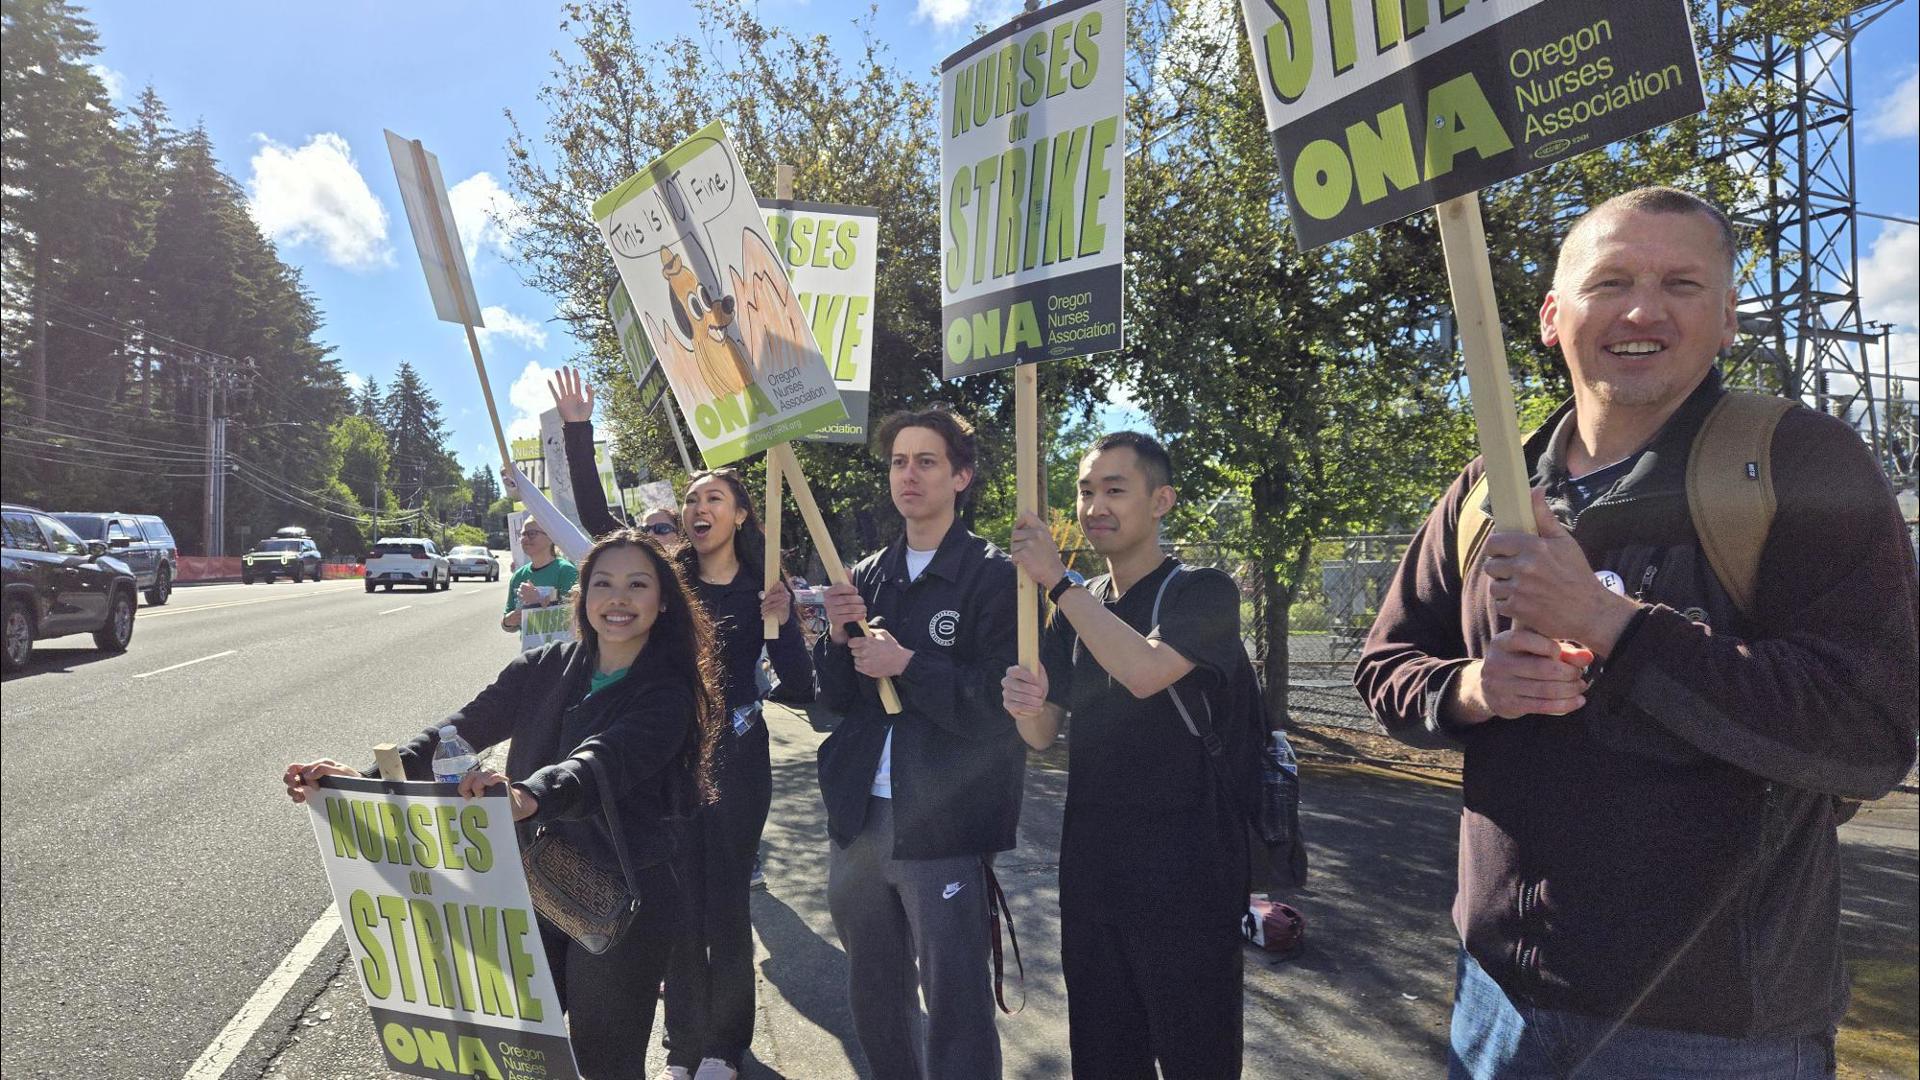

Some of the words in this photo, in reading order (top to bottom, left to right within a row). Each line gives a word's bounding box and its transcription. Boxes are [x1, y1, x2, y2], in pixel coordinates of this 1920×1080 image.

[952, 12, 1102, 138] NURSES
[1509, 19, 1612, 78] Oregon
[1515, 55, 1615, 112] Nurses
[1524, 62, 1683, 143] Association
[1008, 112, 1029, 144] ON
[1293, 72, 1514, 220] ONA
[611, 223, 645, 251] This
[653, 170, 695, 226] NOT
[946, 115, 1118, 294] STRIKE
[767, 215, 860, 270] RSES
[1047, 291, 1092, 311] Oregon
[1047, 310, 1090, 328] Nurses
[947, 300, 1043, 365] ONA
[1047, 321, 1116, 345] Association
[767, 366, 801, 386] Oregon
[773, 380, 805, 400] Nurses
[779, 385, 827, 412] Association
[695, 382, 779, 440] ONA
[814, 423, 863, 435] ociation
[325, 797, 494, 873] NURSES
[409, 870, 433, 895] ON
[350, 889, 544, 1023] STRIKE
[383, 1022, 503, 1080] ONA
[498, 1041, 545, 1061] Oregon
[502, 1056, 547, 1076] Nurses
